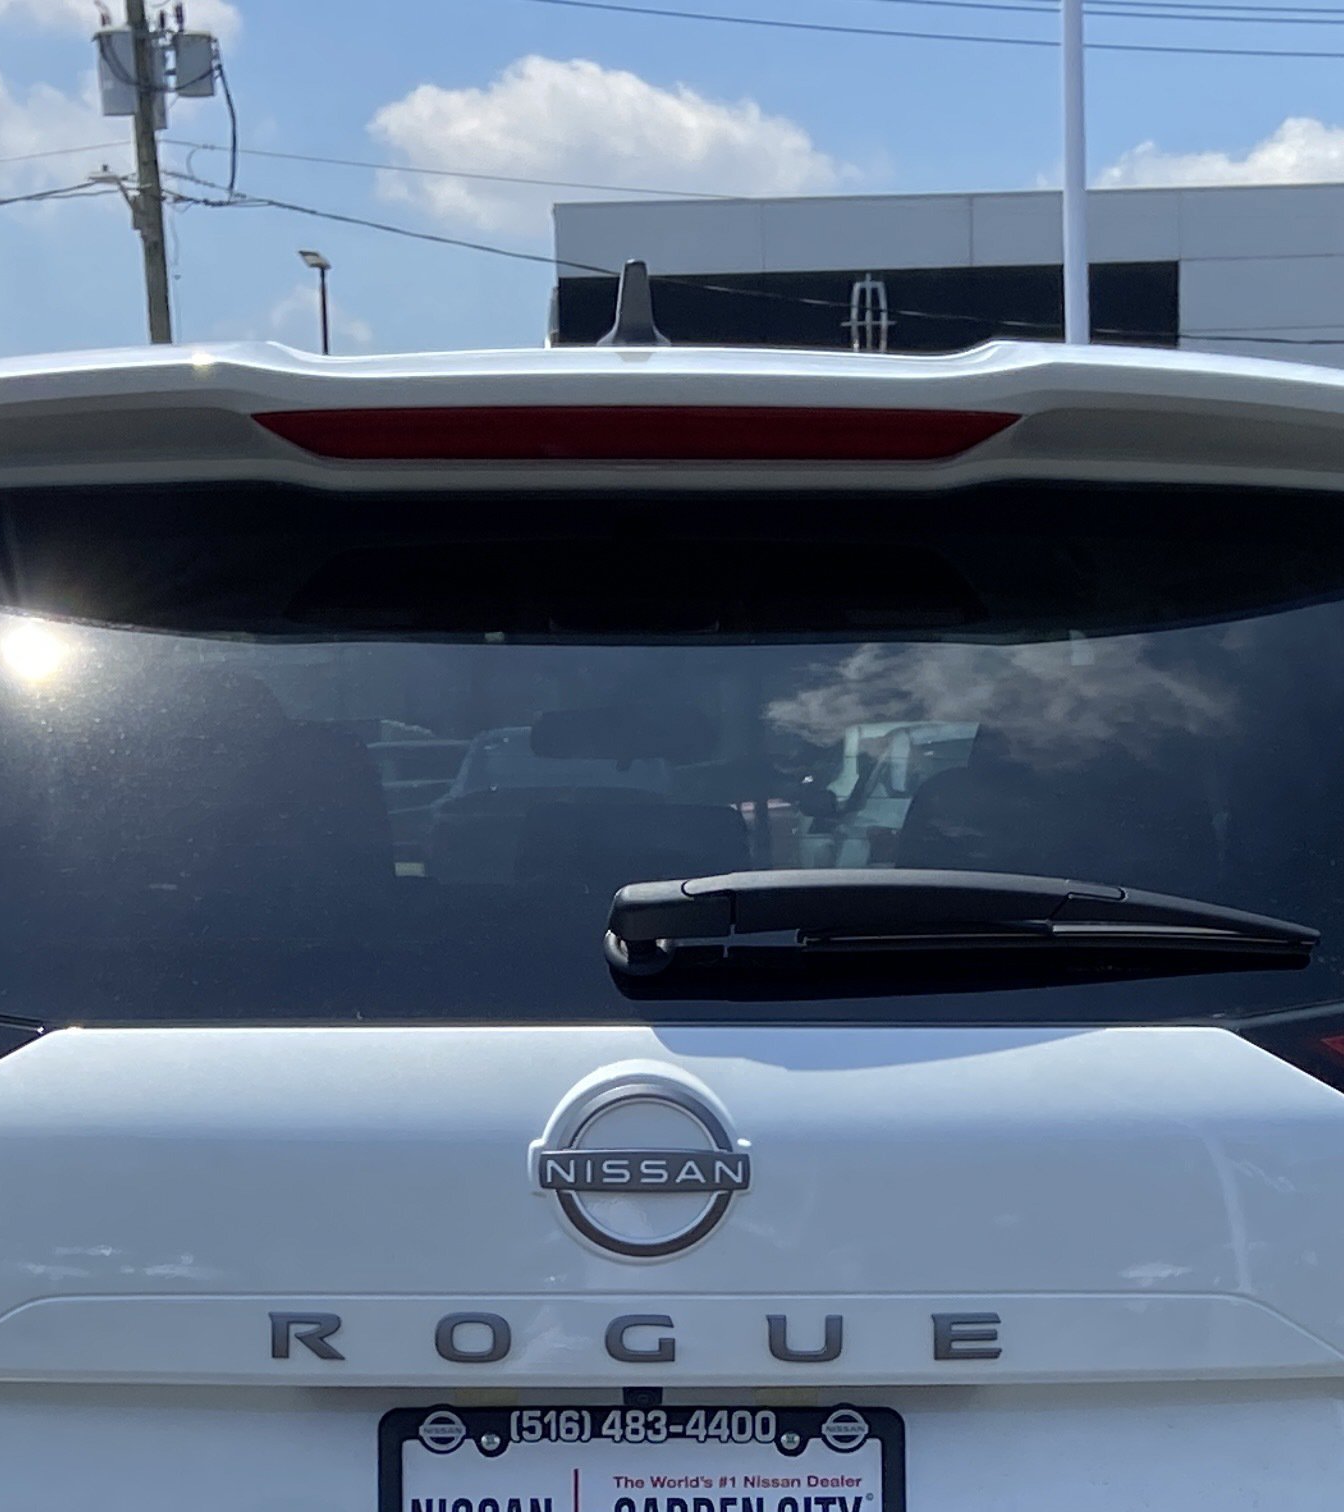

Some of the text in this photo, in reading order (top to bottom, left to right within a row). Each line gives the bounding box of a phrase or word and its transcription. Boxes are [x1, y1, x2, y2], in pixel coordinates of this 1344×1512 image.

[546, 1159, 745, 1184] NISSAN
[268, 1311, 1003, 1363] ROGUE
[423, 1426, 462, 1436] NISSAN
[510, 1410, 777, 1443] (516) 483-4400
[825, 1424, 865, 1434] NISSAN
[613, 1475, 863, 1489] The World's #1 Nissan Dealer
